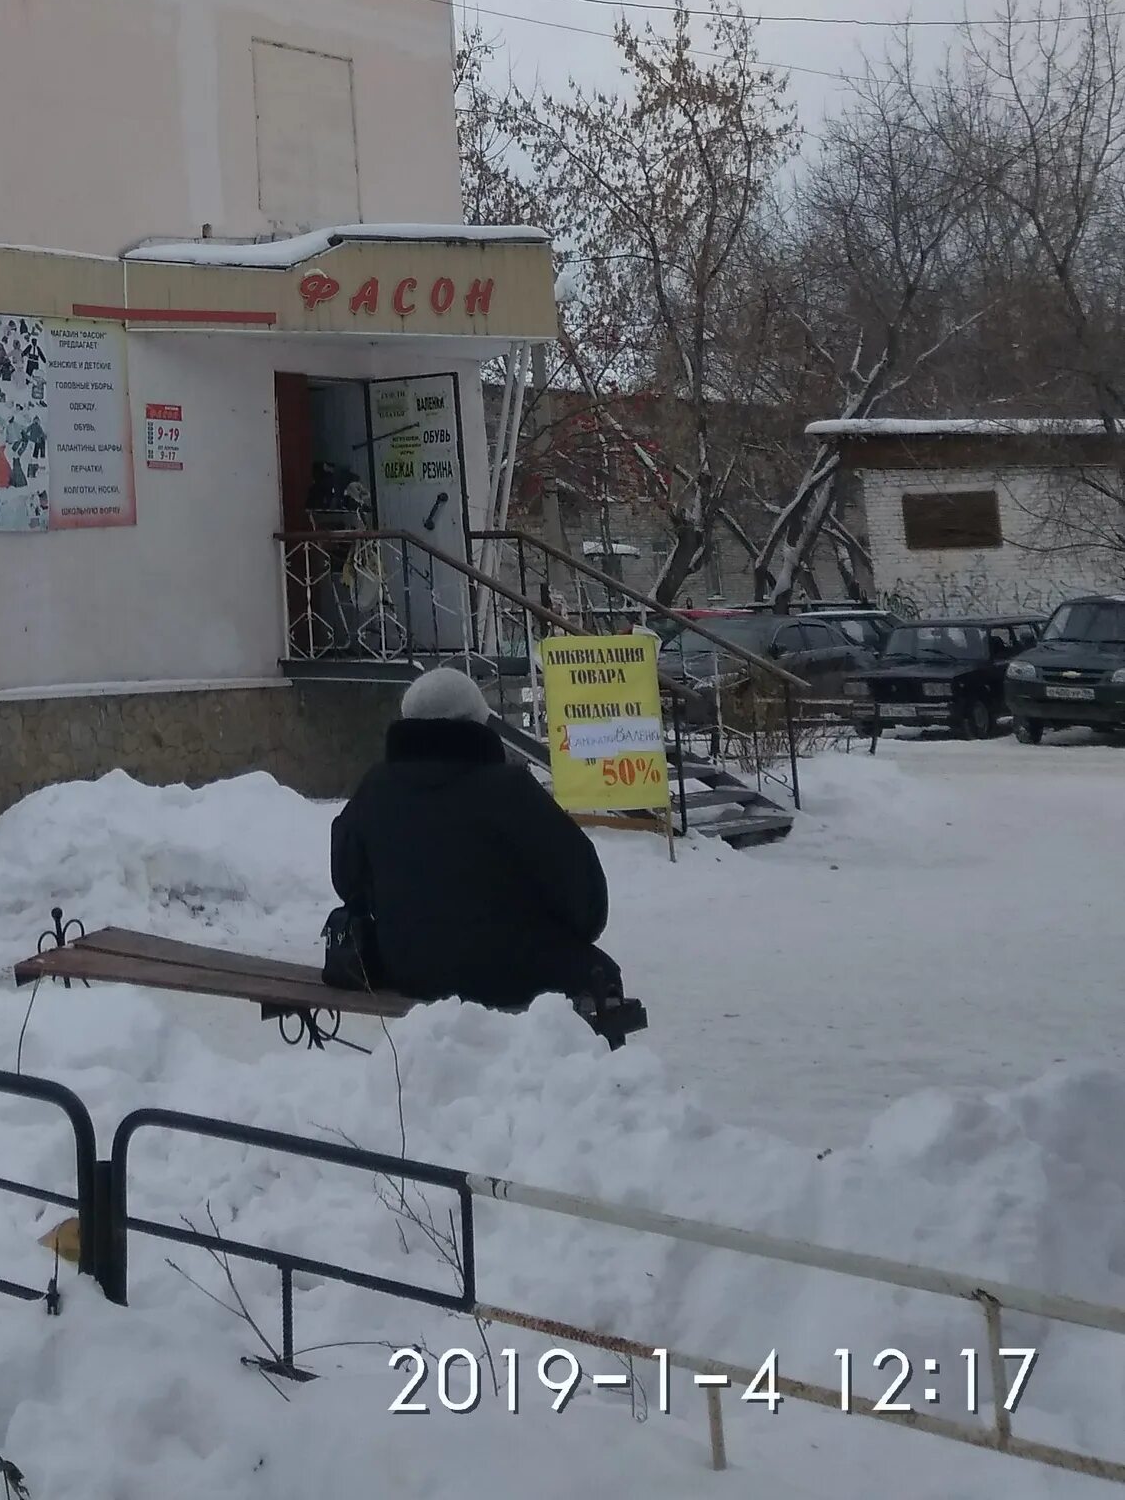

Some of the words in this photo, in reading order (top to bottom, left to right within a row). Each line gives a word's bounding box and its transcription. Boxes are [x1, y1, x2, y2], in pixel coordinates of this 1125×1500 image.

[300, 273, 494, 317] ФАСОН
[50, 330, 79, 338] МАГАЗИН
[48, 361, 77, 369] ЖЕНСКИЕ
[84, 361, 111, 370] ДЕТСКИЕ
[55, 381, 90, 390] ГОЛОВНЫЕ
[416, 396, 445, 412] ВАЛЕНКИ
[157, 426, 180, 442] 9-19
[423, 429, 451, 443] ОБУВЬ
[384, 461, 415, 478] ОДЕЖДА
[422, 460, 453, 479] РЕЗИНА
[547, 648, 645, 666] ЛИКВИДАЦИЯ
[569, 668, 626, 685] ТОВАРА
[564, 702, 621, 720] СКИДКИ
[625, 702, 642, 717] ОТ
[602, 757, 661, 787] 50%
